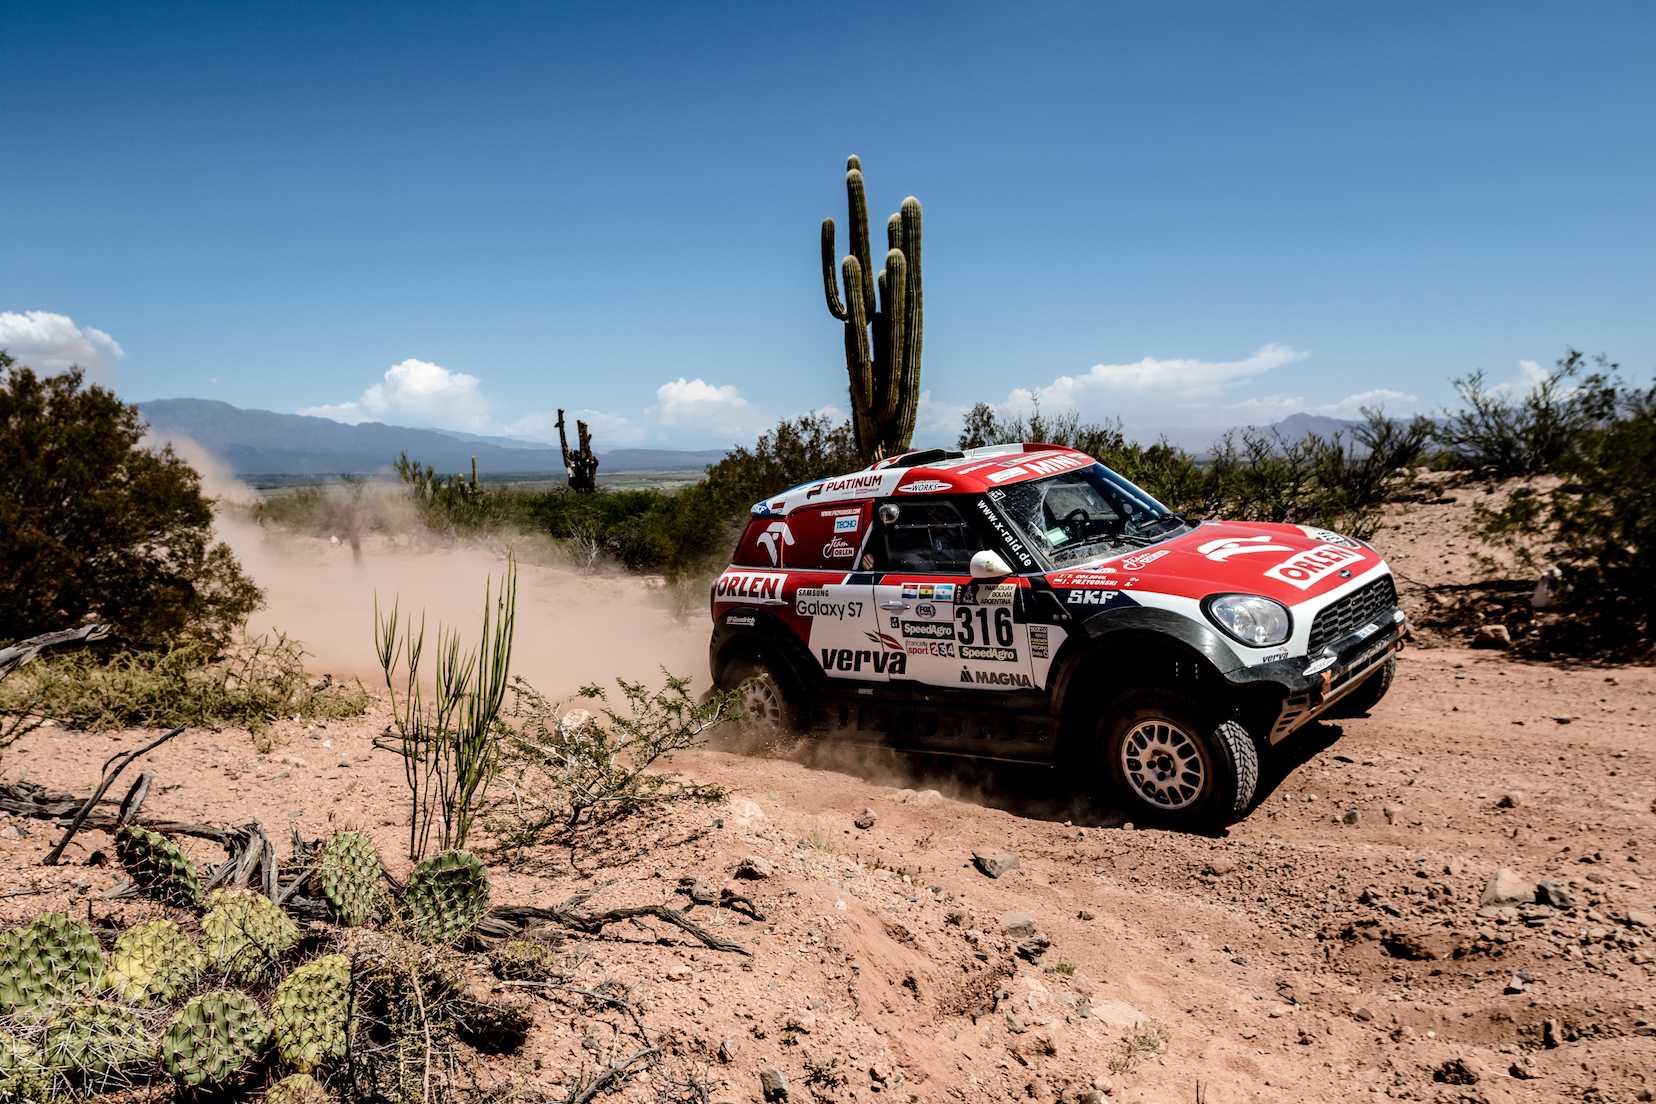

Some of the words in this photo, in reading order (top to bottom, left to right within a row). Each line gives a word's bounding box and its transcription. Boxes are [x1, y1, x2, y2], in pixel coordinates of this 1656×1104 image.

[1024, 455, 1082, 476] MINI
[826, 475, 882, 492] PLATINUM
[912, 483, 938, 491] WORKS
[977, 500, 1032, 567] www.x-raid.de
[834, 548, 853, 556] ORLEN
[1279, 546, 1355, 580] ORLEN
[716, 576, 779, 599] ORLEN
[798, 589, 829, 597] SAMSUNG
[1067, 590, 1119, 605] SKF
[797, 600, 845, 621] Galaxy
[848, 602, 863, 617] S7
[904, 623, 952, 637] SpeedAgro
[955, 606, 1014, 647] 316
[820, 648, 907, 675] verva
[962, 647, 1014, 661] SpeedAgro
[975, 671, 1032, 688] MAGNA
